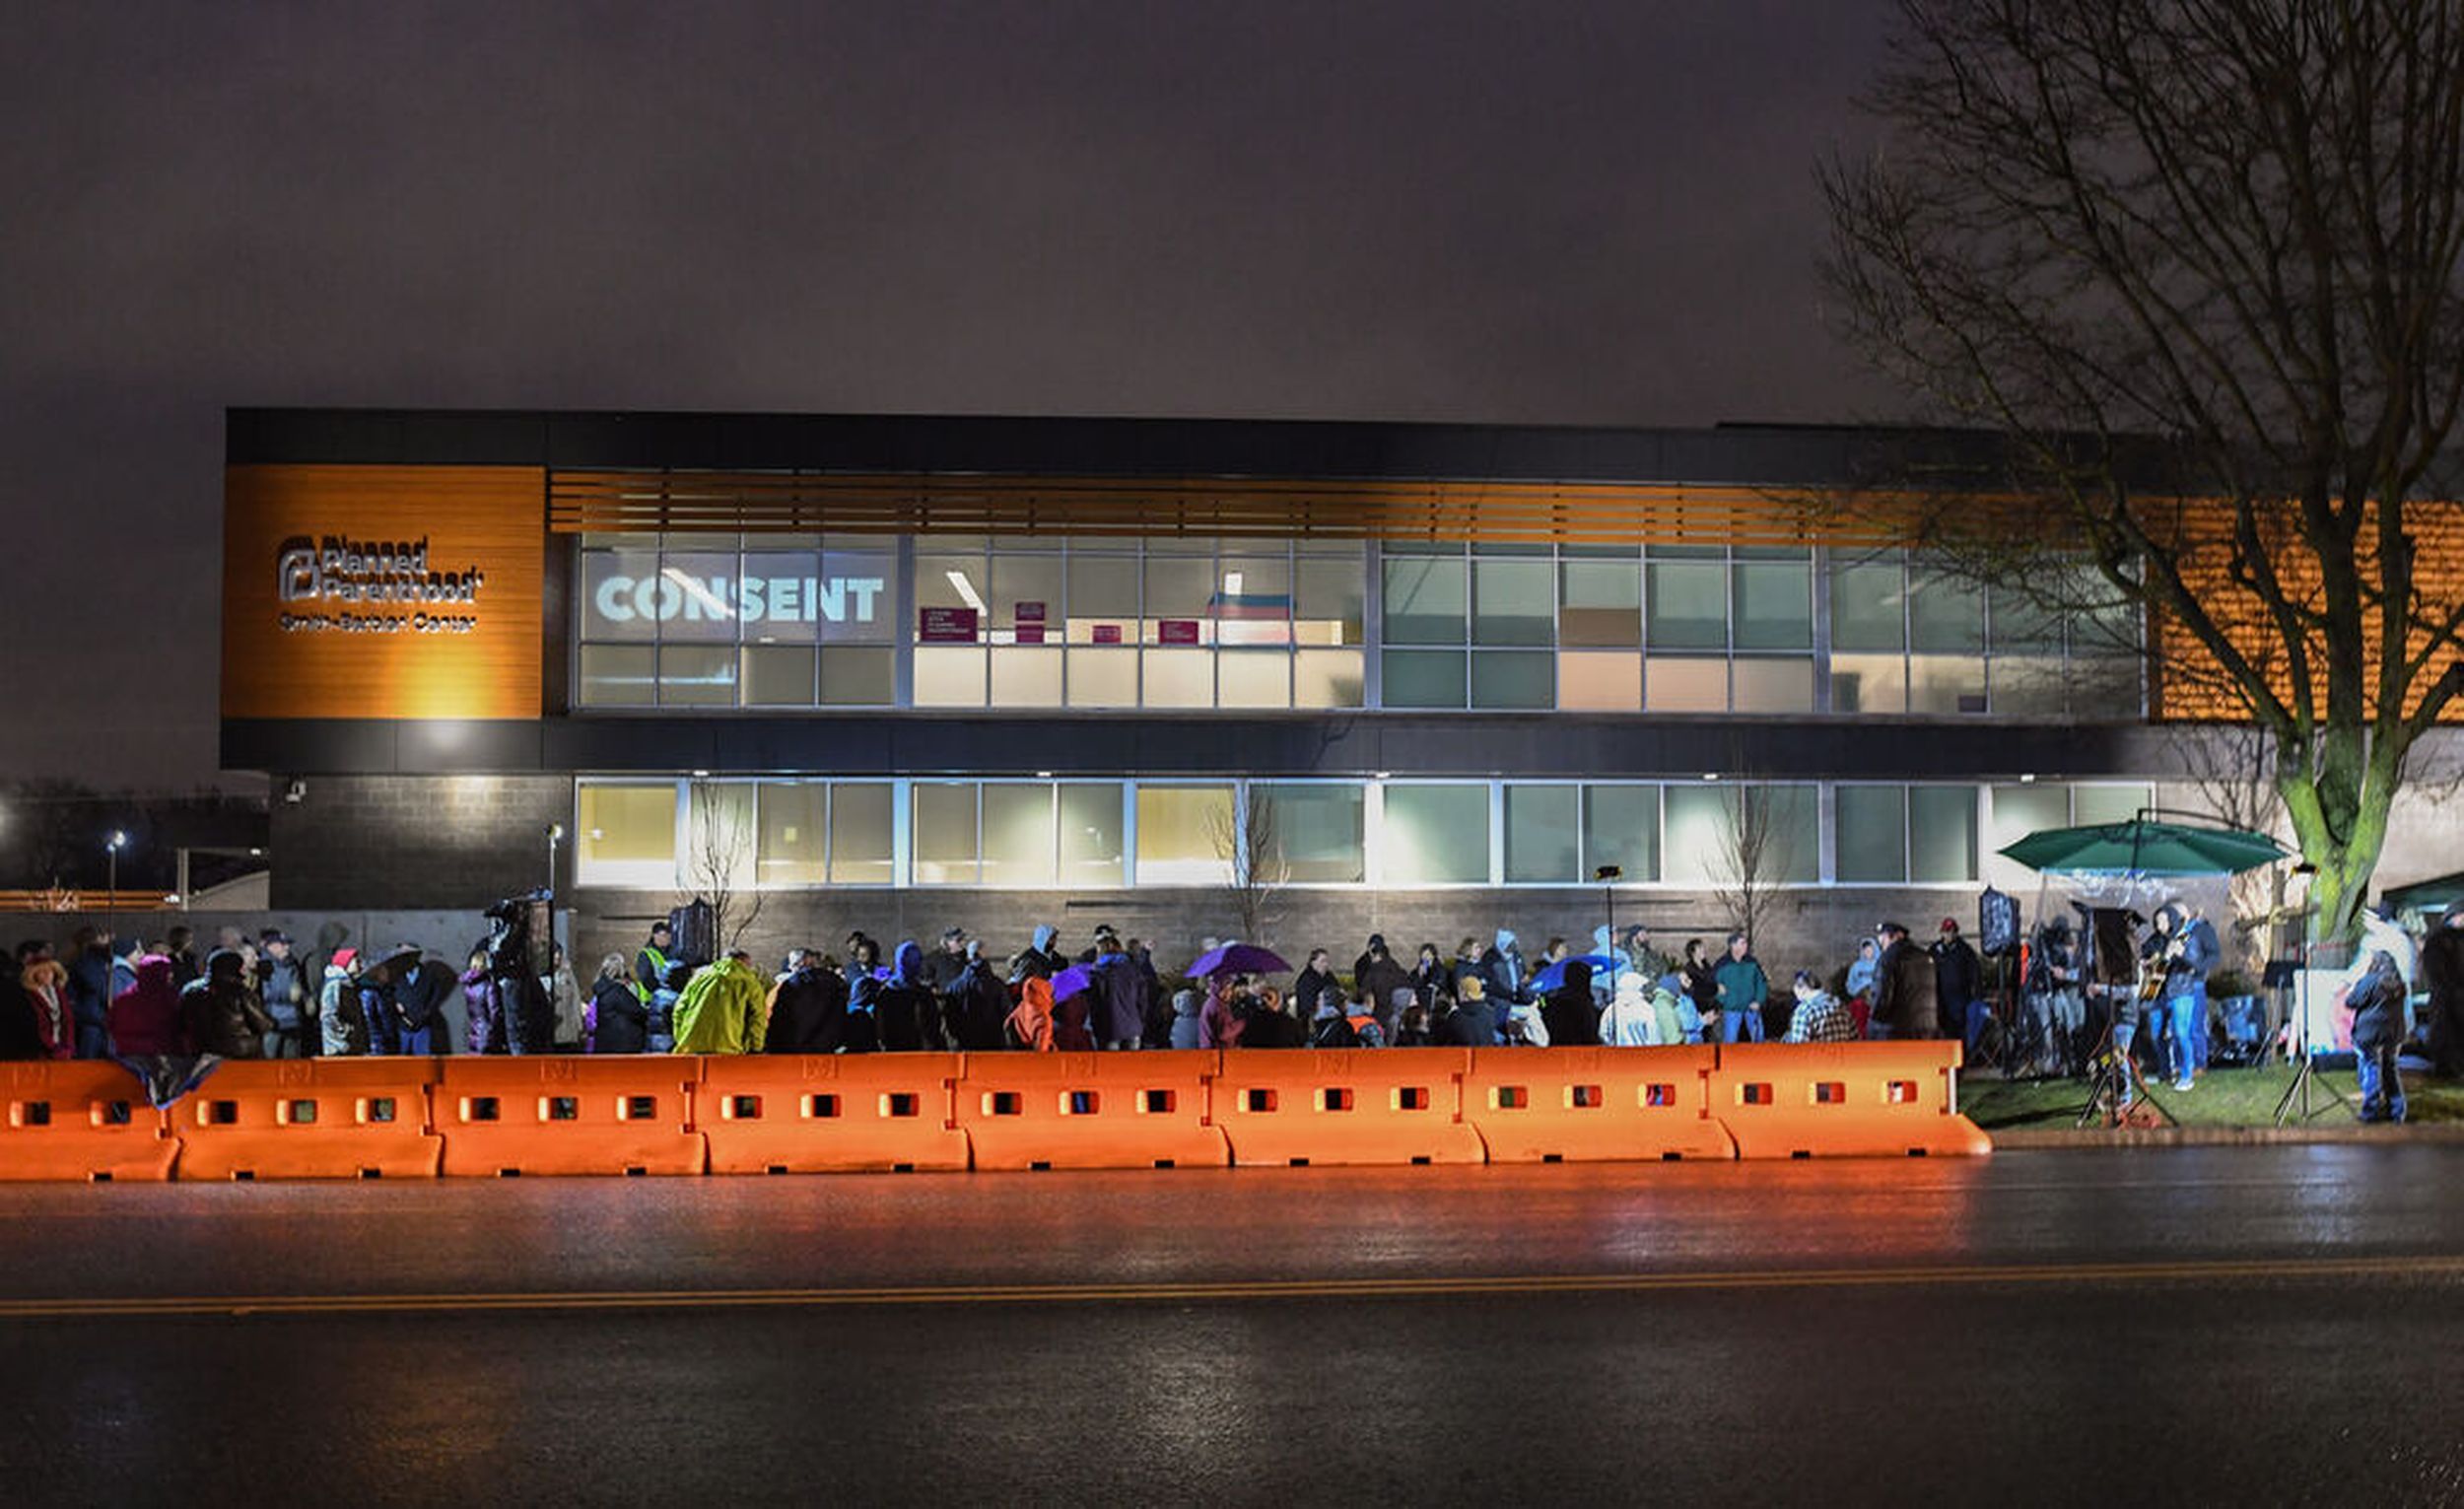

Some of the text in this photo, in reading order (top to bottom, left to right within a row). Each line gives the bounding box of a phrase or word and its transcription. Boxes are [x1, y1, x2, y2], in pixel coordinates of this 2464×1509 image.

[322, 543, 428, 575] Planned
[322, 573, 479, 603] Parenthood
[595, 577, 884, 622] CONSENT
